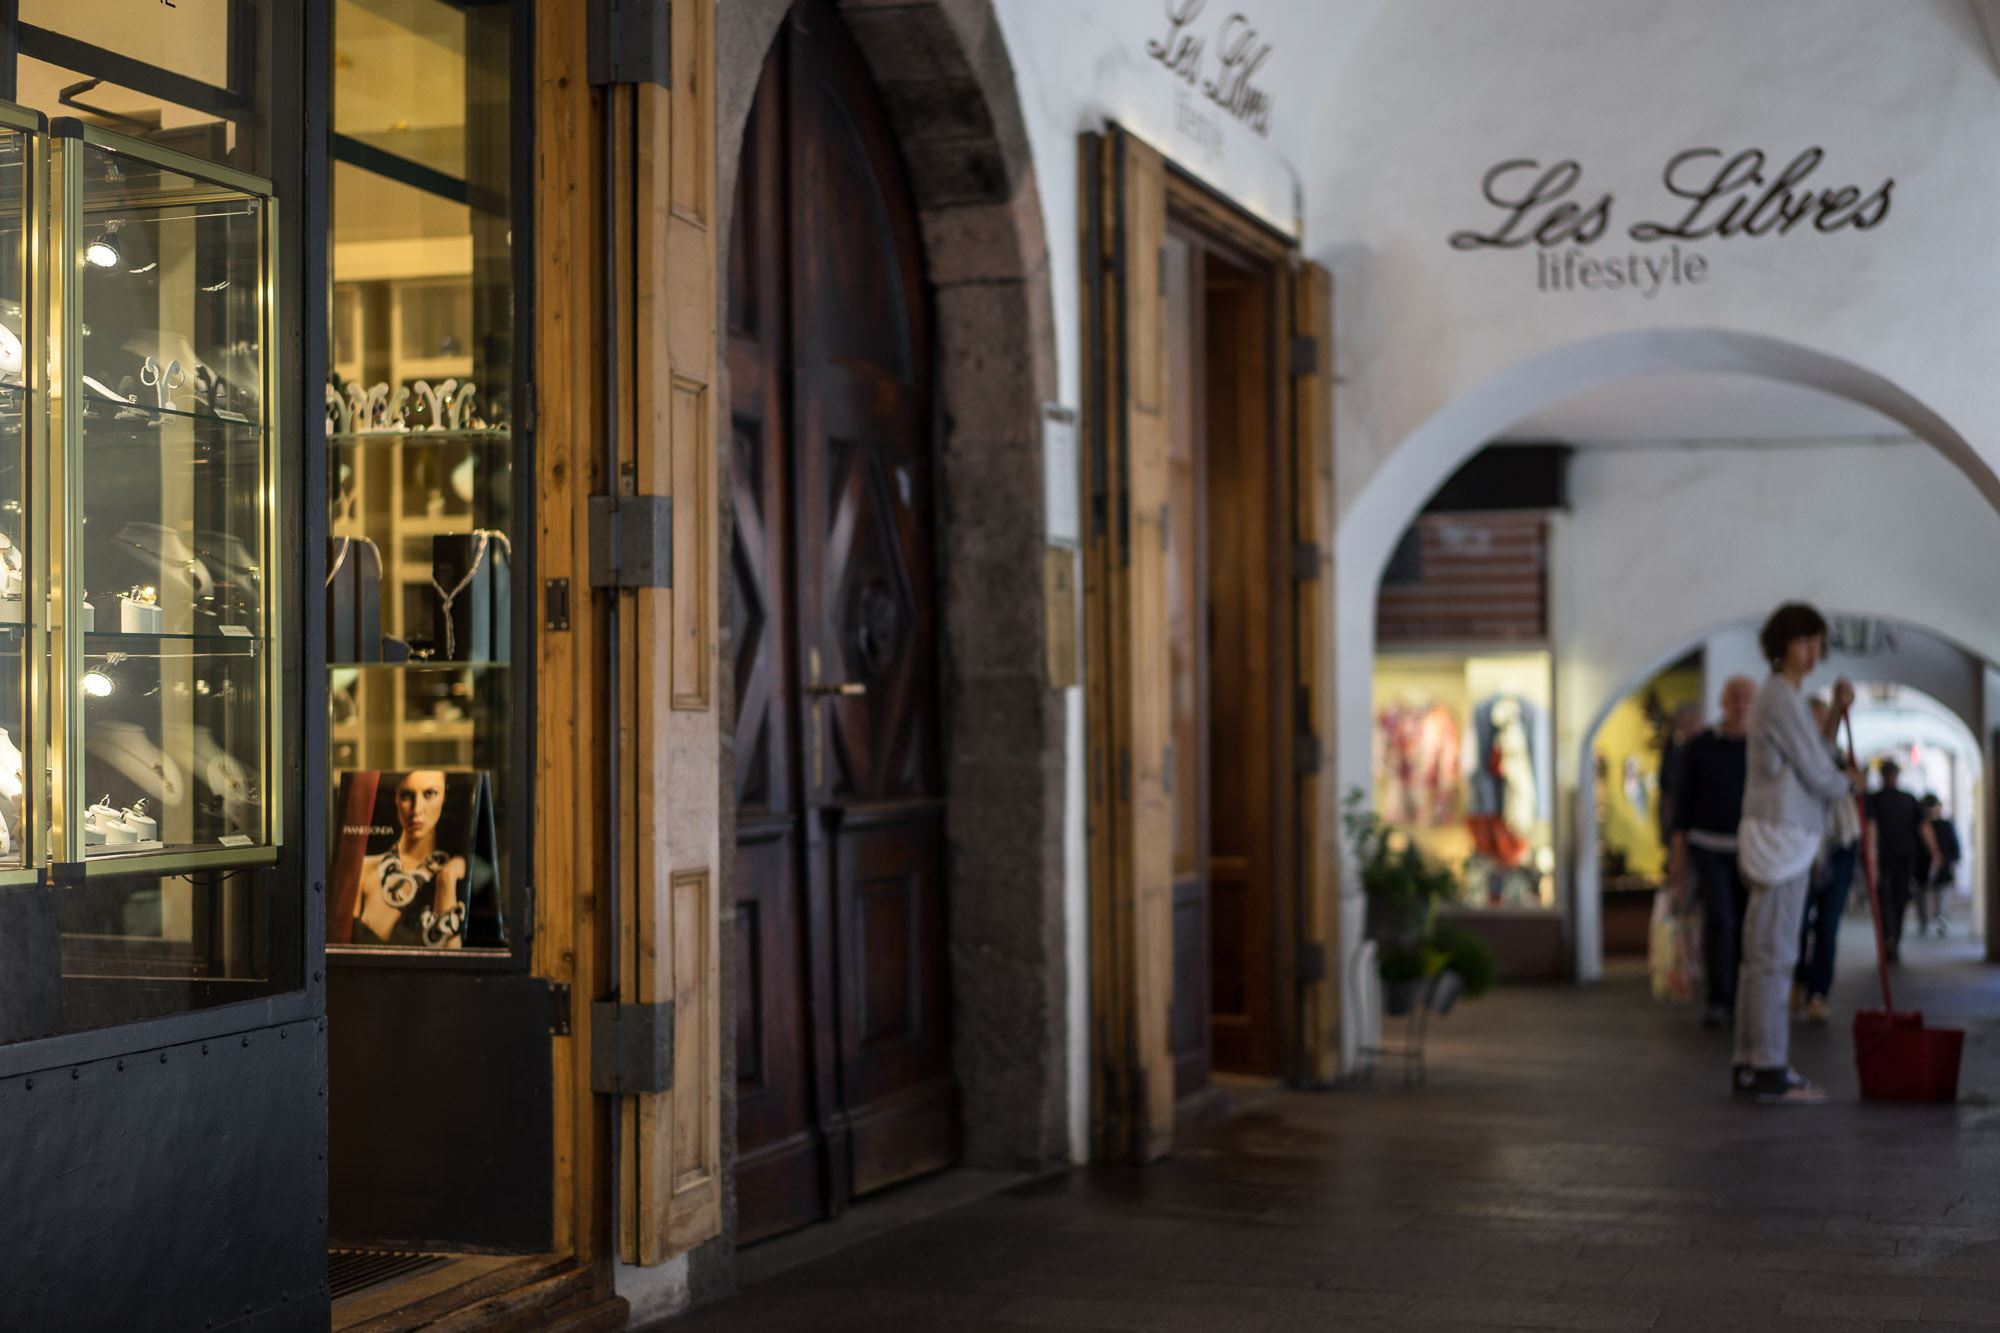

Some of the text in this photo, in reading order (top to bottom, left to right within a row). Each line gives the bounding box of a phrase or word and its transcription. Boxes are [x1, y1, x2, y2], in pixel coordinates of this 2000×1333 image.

[1448, 146, 1896, 251] Les Libres
[1536, 244, 1708, 298] lifestyle
